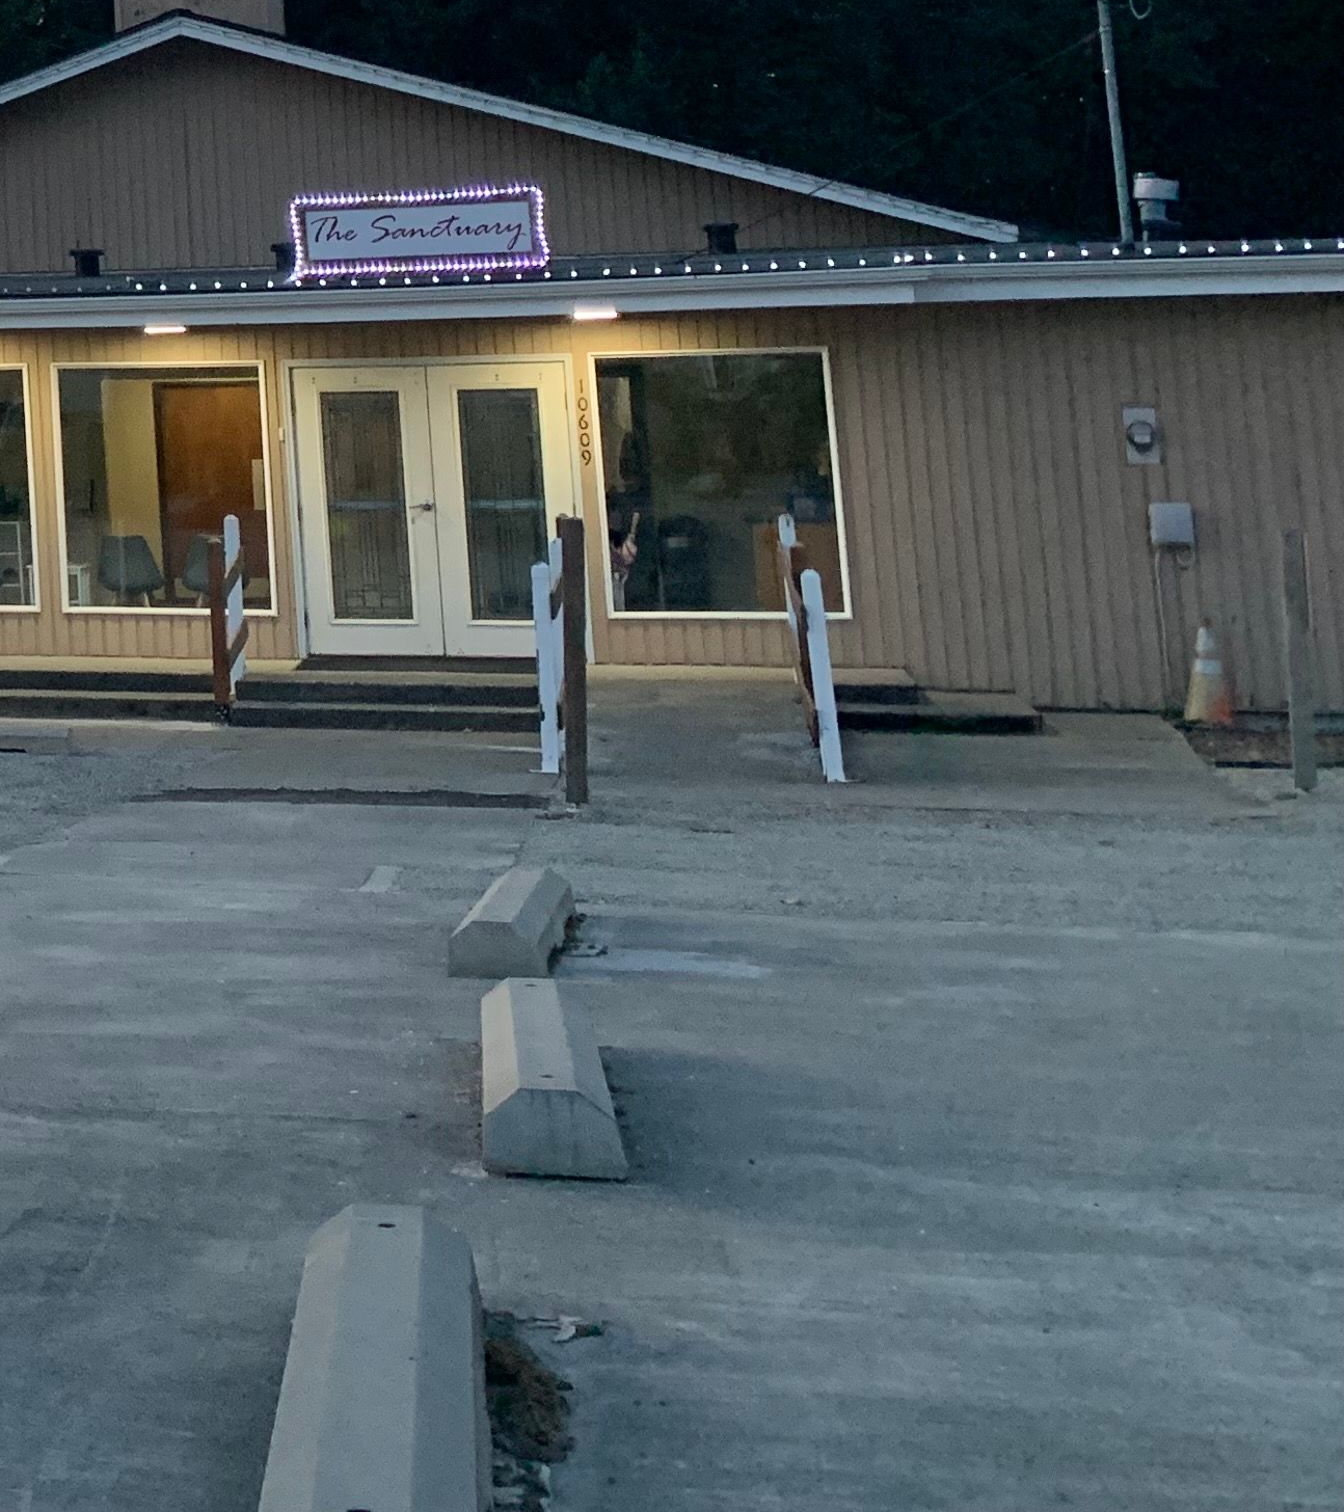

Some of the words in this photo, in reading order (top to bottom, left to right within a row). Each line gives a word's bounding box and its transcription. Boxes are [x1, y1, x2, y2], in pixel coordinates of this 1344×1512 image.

[310, 215, 357, 243] The
[369, 214, 525, 251] Sanctuary
[577, 379, 592, 466] 10609
